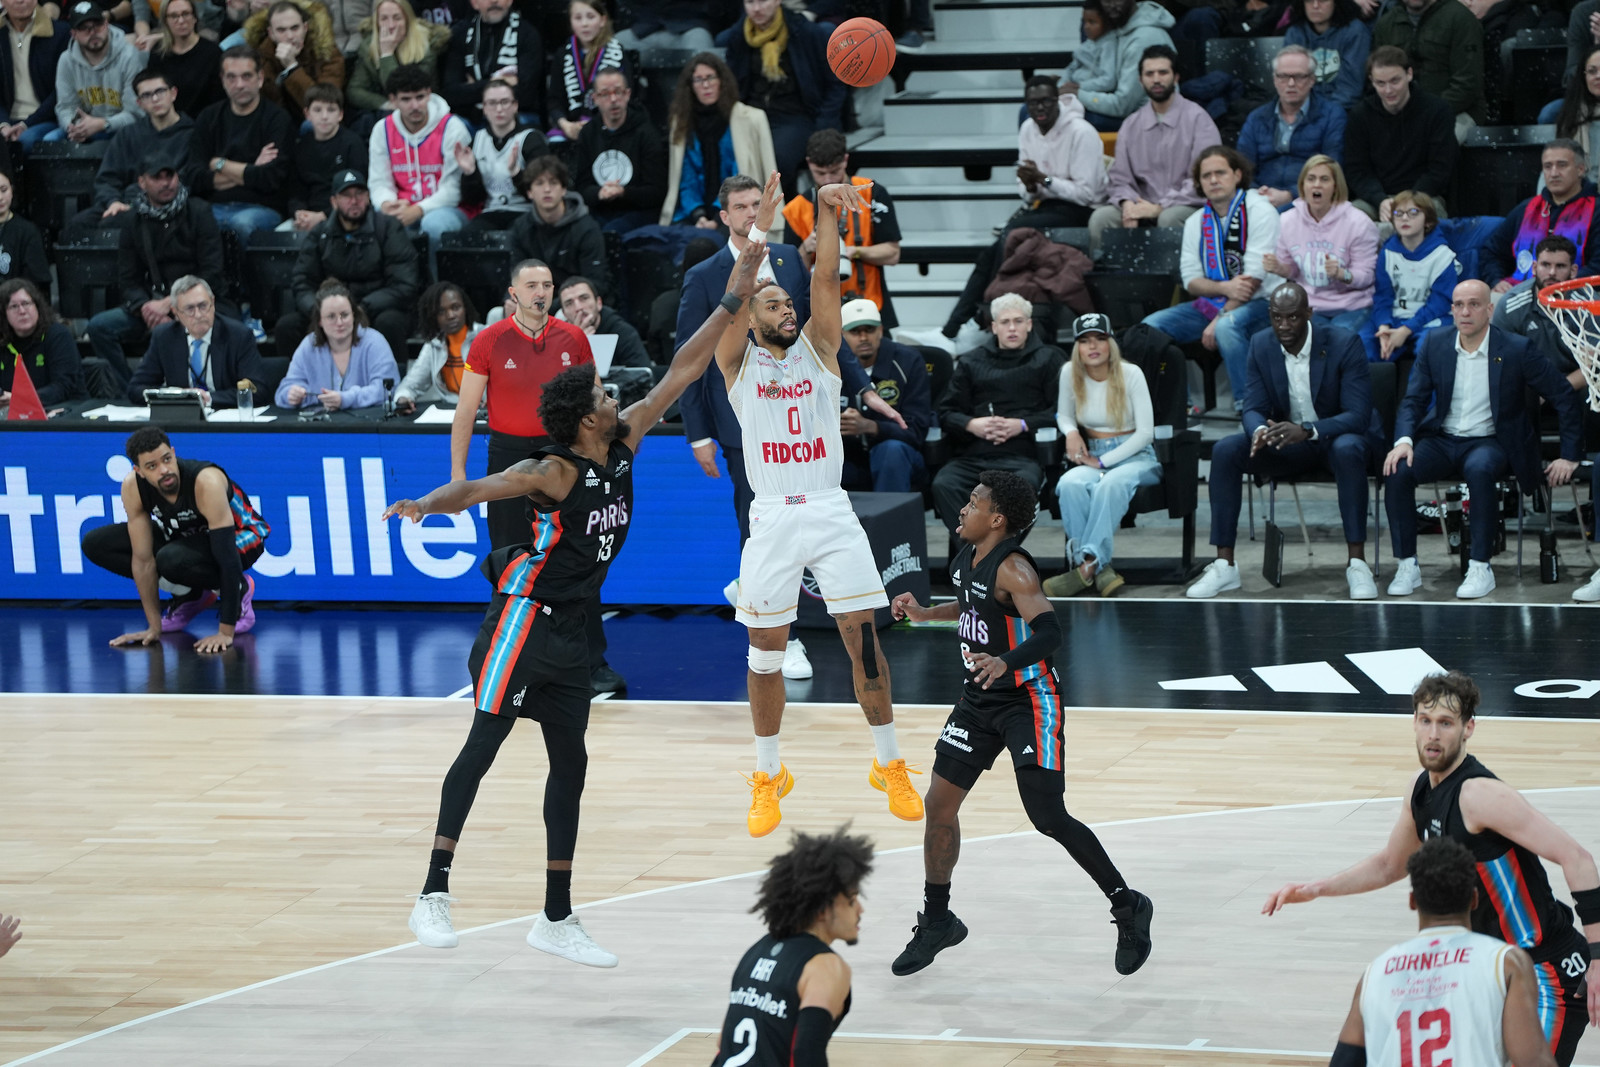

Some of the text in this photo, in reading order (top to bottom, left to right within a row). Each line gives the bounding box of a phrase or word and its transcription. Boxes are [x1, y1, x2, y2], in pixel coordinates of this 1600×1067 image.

[787, 406, 802, 435] 0
[762, 437, 827, 464] FIDCOM
[585, 494, 629, 535] PARIS
[596, 534, 615, 562] 13
[891, 542, 911, 563] PARIS
[882, 556, 922, 586] BASKETBALL
[1384, 946, 1474, 975] CORNELIE
[1561, 951, 1587, 978] 20
[722, 1017, 758, 1067] 2
[1396, 1007, 1453, 1067] 12
